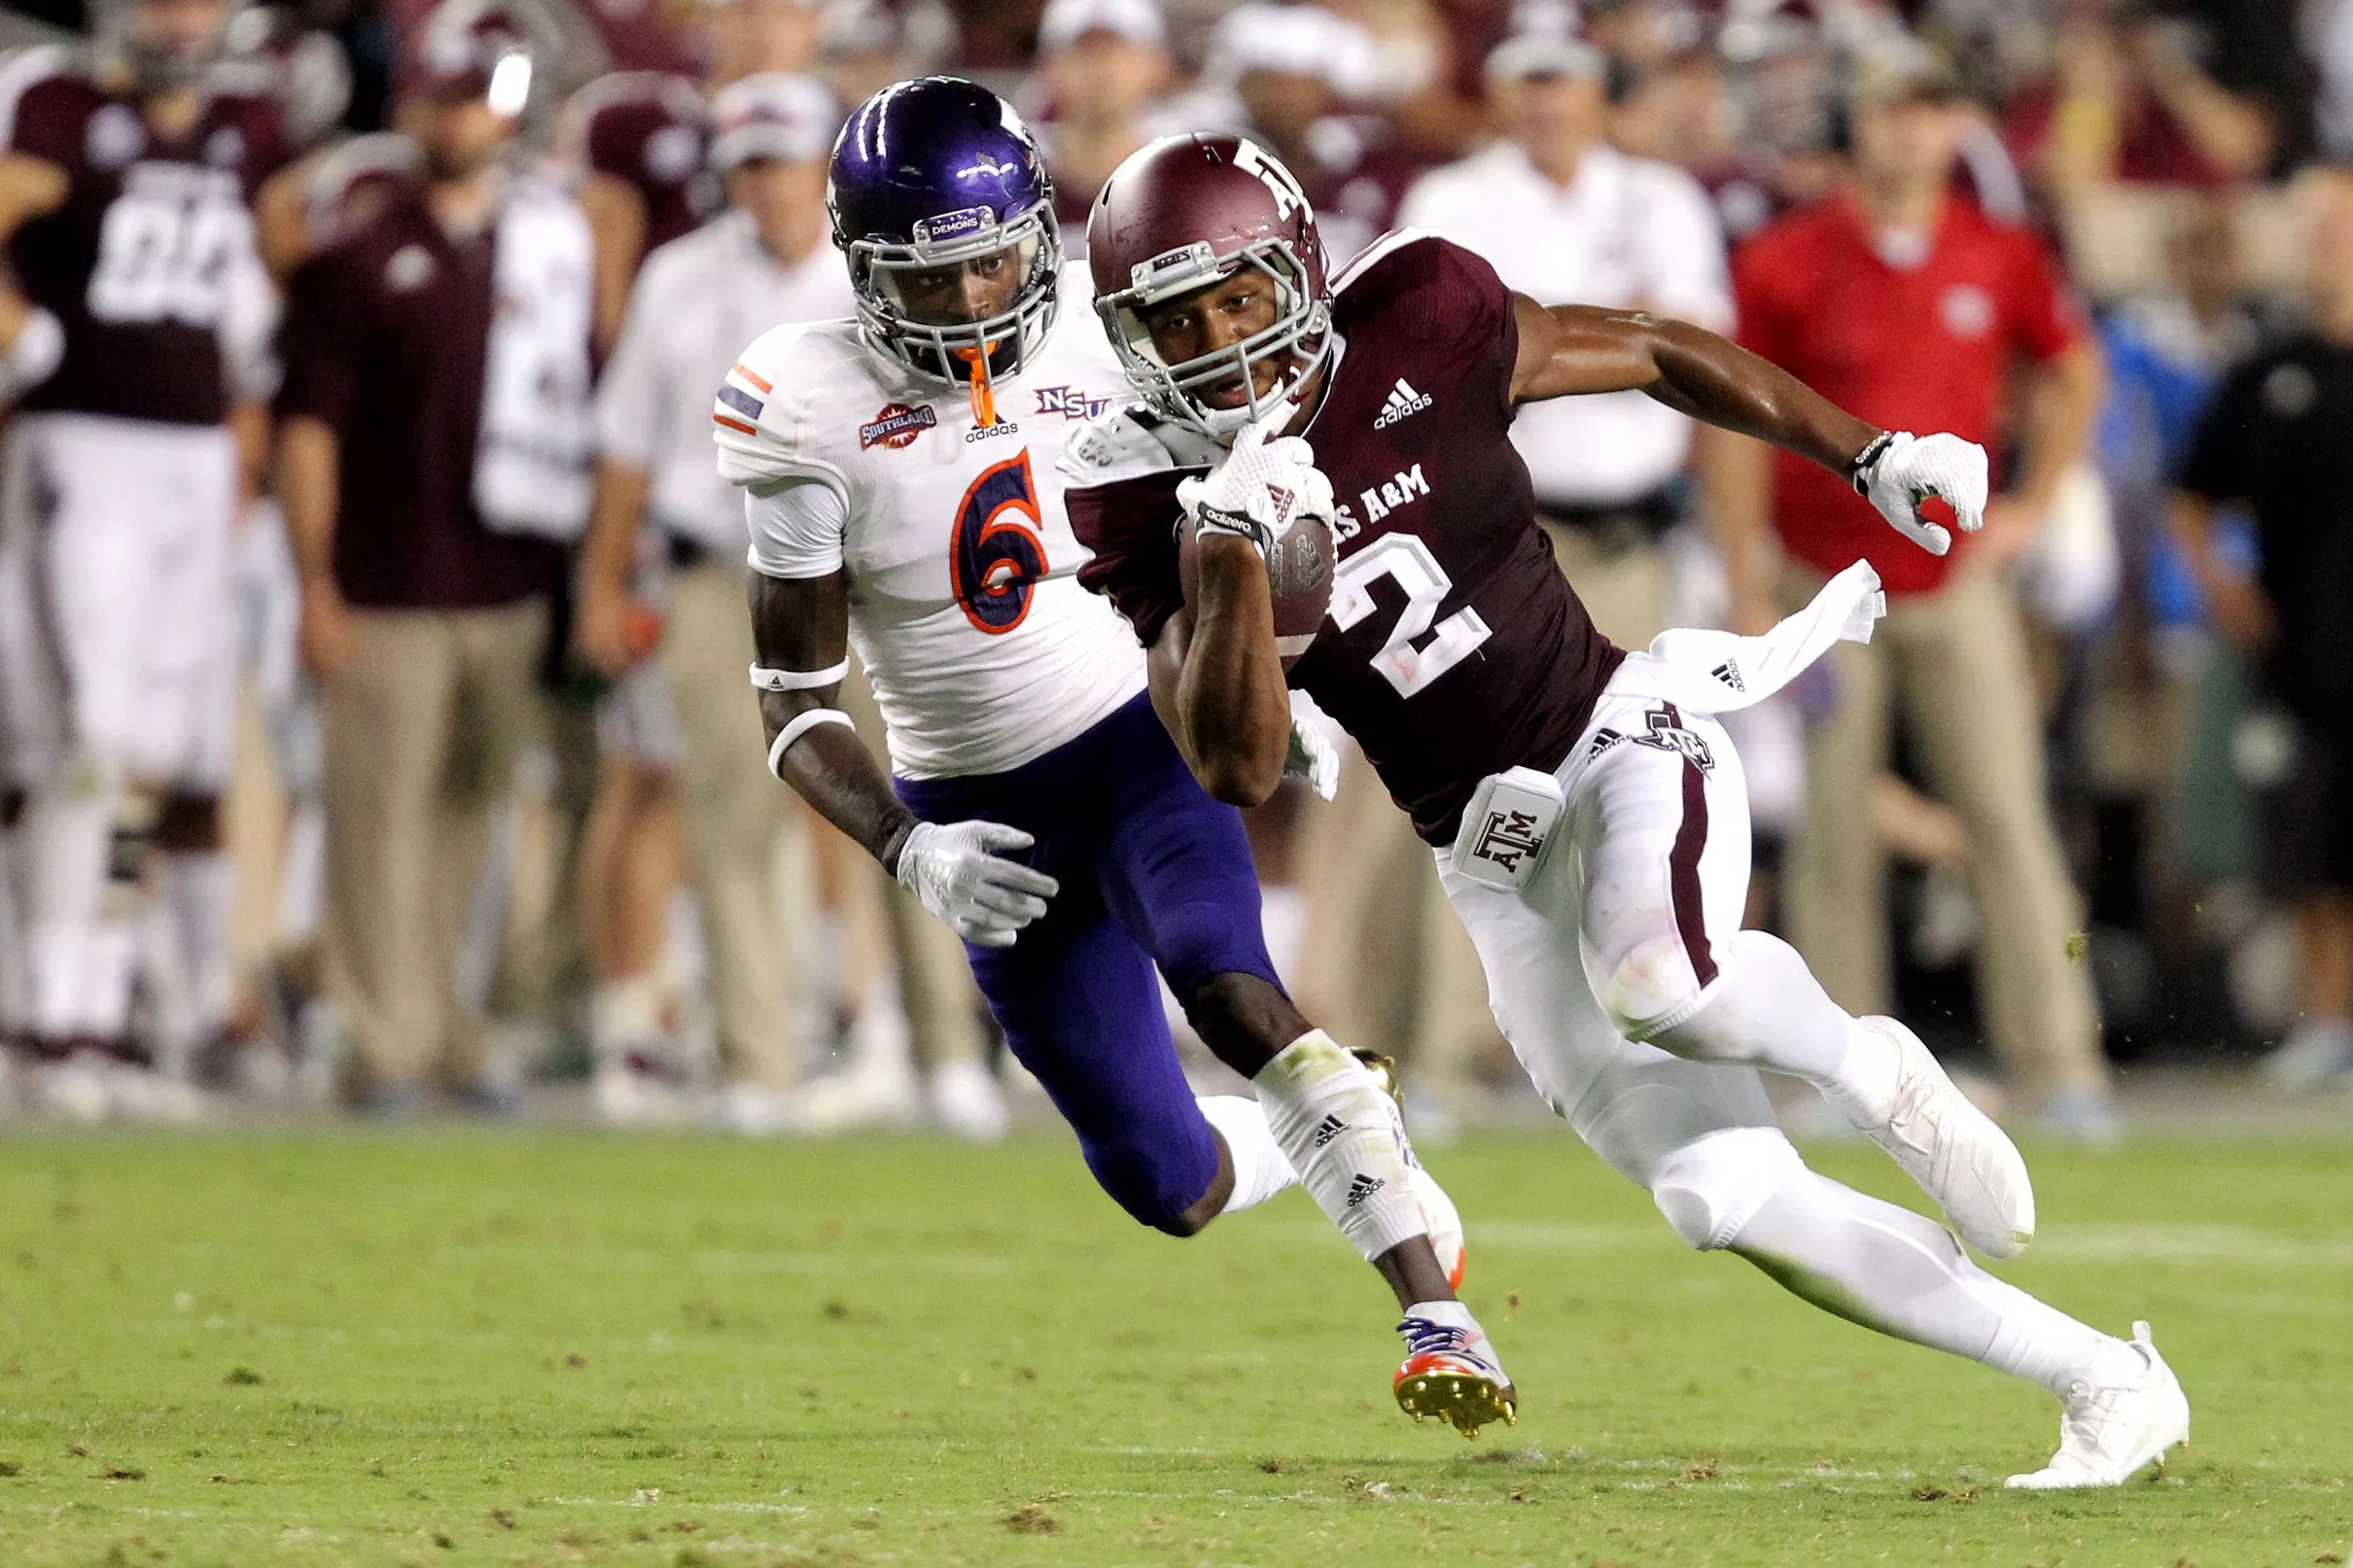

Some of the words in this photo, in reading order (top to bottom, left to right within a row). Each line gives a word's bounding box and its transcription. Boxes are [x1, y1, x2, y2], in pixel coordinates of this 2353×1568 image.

[931, 217, 978, 235] DEMONS
[1036, 387, 1108, 421] NSU
[1374, 393, 1433, 430] adidas
[861, 405, 936, 445] SOUTHLAND
[966, 422, 1019, 443] adidas
[1359, 463, 1431, 524] A&M
[1205, 508, 1252, 532] adizero
[950, 445, 1050, 636] 6
[1331, 531, 1493, 700] 2
[1348, 1178, 1386, 1206] adidas
